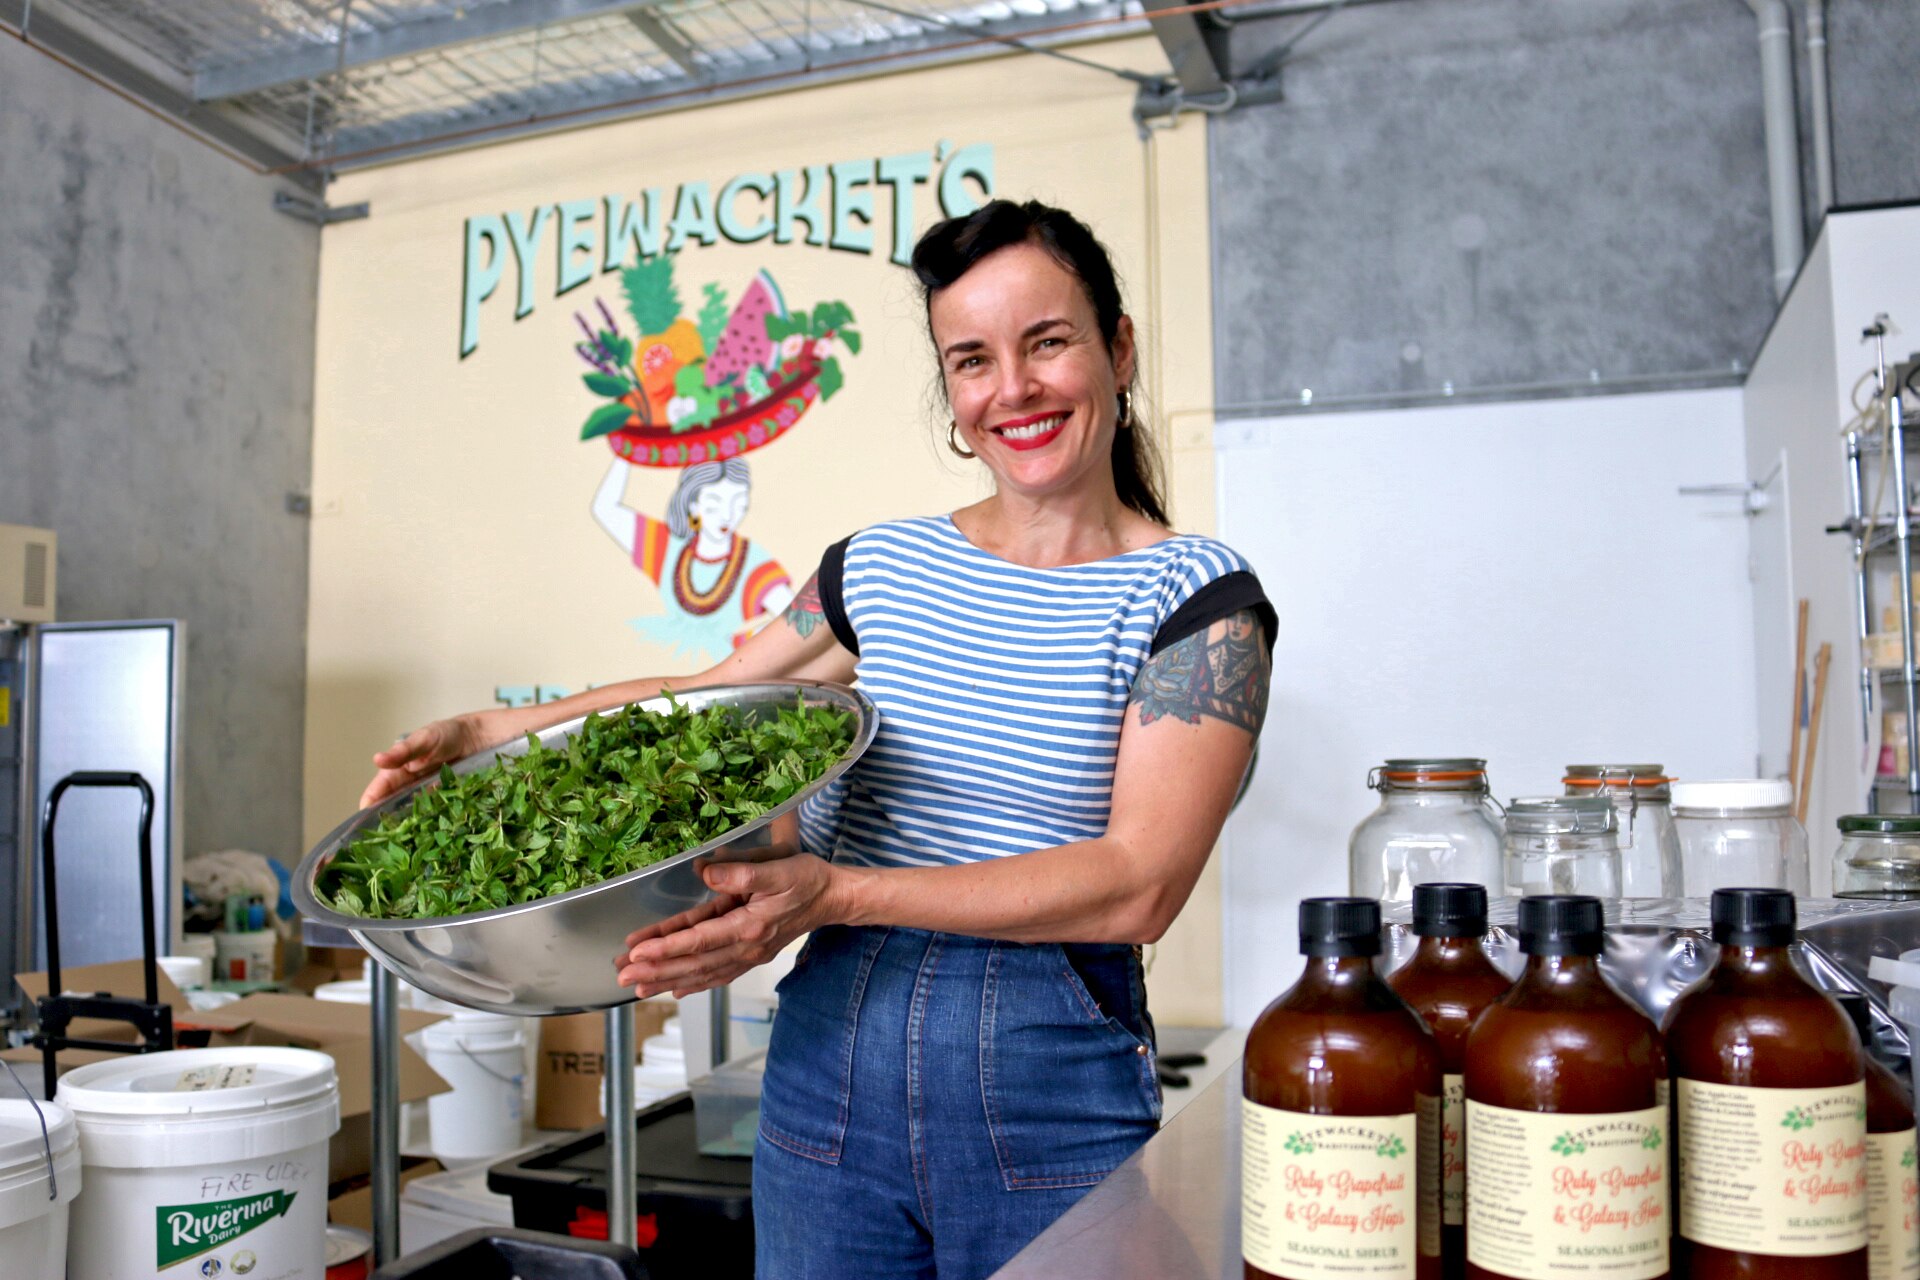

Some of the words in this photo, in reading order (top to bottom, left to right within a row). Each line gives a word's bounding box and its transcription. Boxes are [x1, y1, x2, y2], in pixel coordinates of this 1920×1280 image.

[201, 1173, 261, 1198] FIRE
[1285, 1164, 1325, 1198] Ruby
[1328, 1170, 1405, 1200] Grapefruit
[1552, 1165, 1597, 1199] Ruby
[167, 1195, 274, 1246] Riverina
[215, 1203, 232, 1211] THE
[1298, 1201, 1358, 1234] Galaxy
[1361, 1204, 1405, 1233] Hops
[1569, 1200, 1629, 1233] Galaxy
[208, 1225, 241, 1245] Dairy
[1287, 1241, 1350, 1259] SEASONAL
